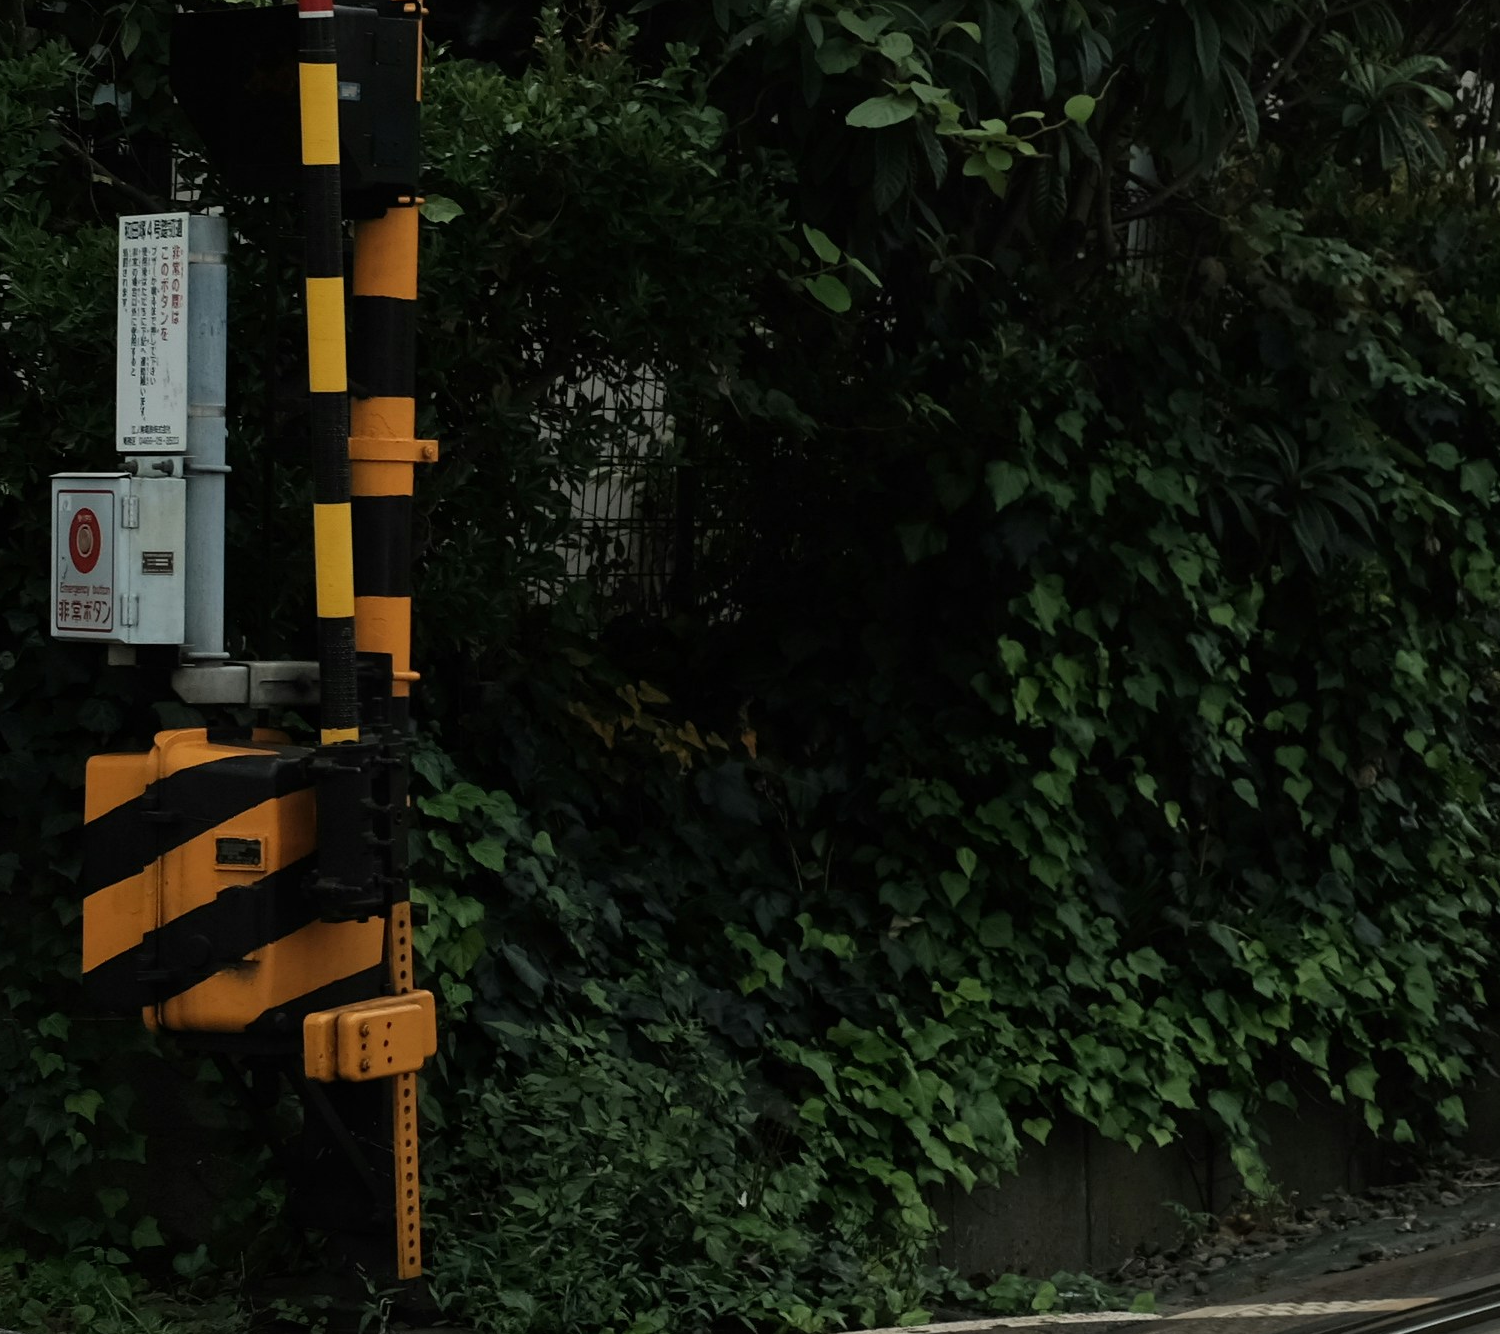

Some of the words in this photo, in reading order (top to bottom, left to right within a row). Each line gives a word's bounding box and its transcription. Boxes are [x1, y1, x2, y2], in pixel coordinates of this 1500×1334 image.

[161, 246, 169, 341] このボタンを
